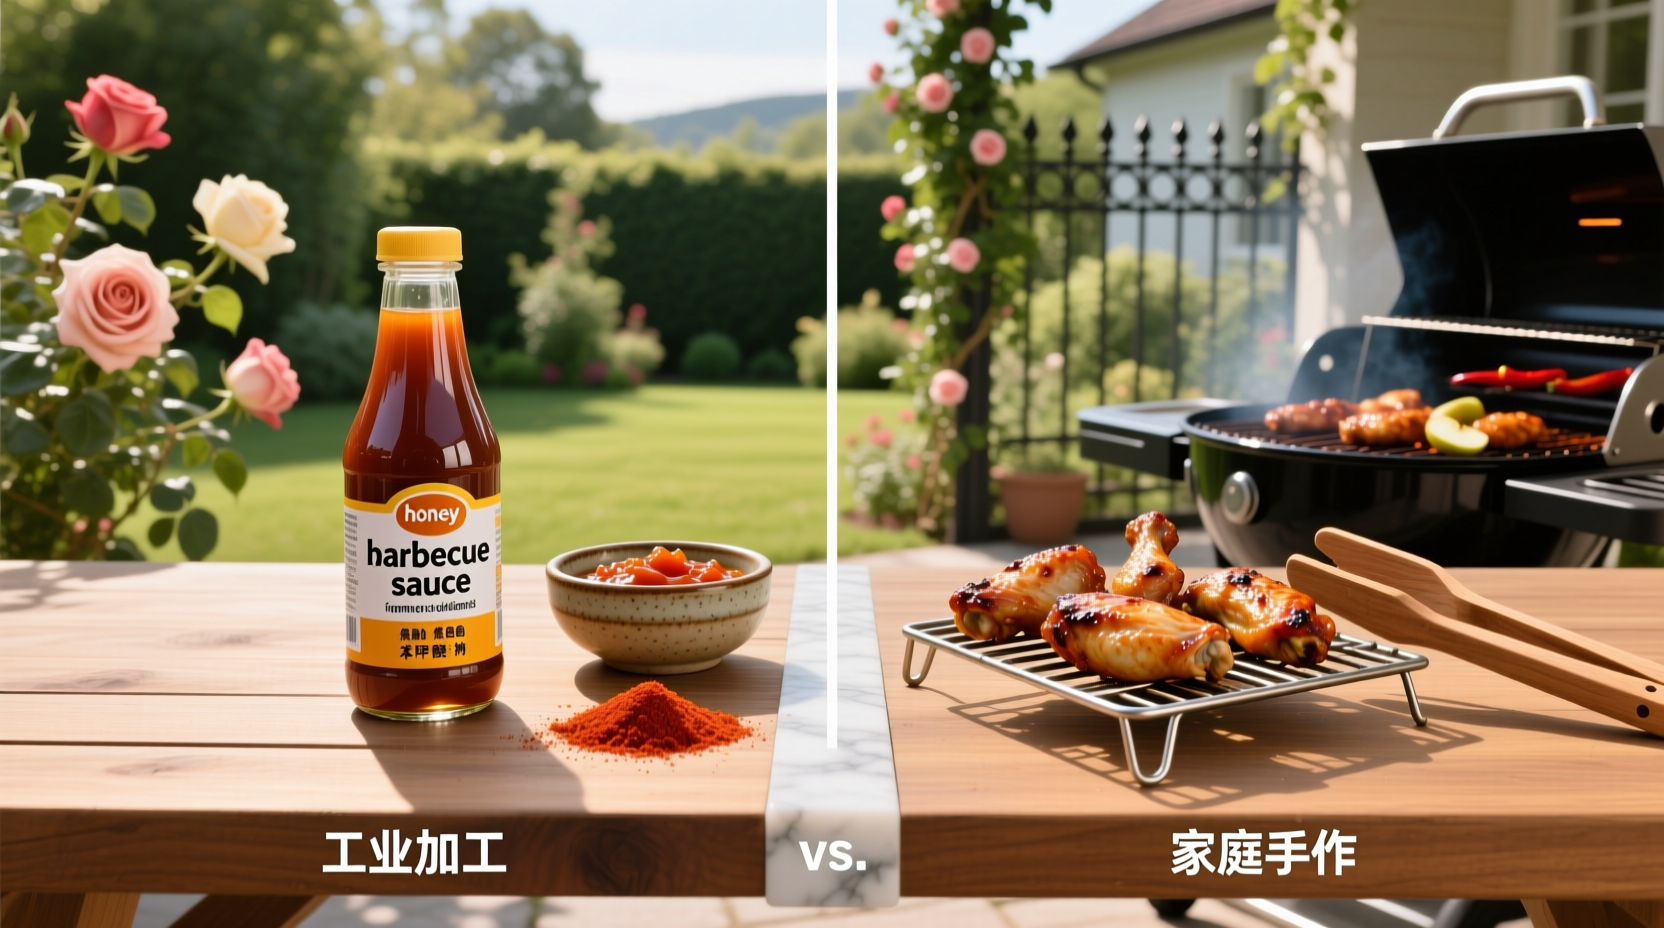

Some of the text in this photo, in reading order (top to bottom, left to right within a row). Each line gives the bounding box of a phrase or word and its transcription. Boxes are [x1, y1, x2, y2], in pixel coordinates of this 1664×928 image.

[404, 503, 461, 526] honey
[367, 538, 490, 569] harbecue
[391, 573, 471, 597] sauce
